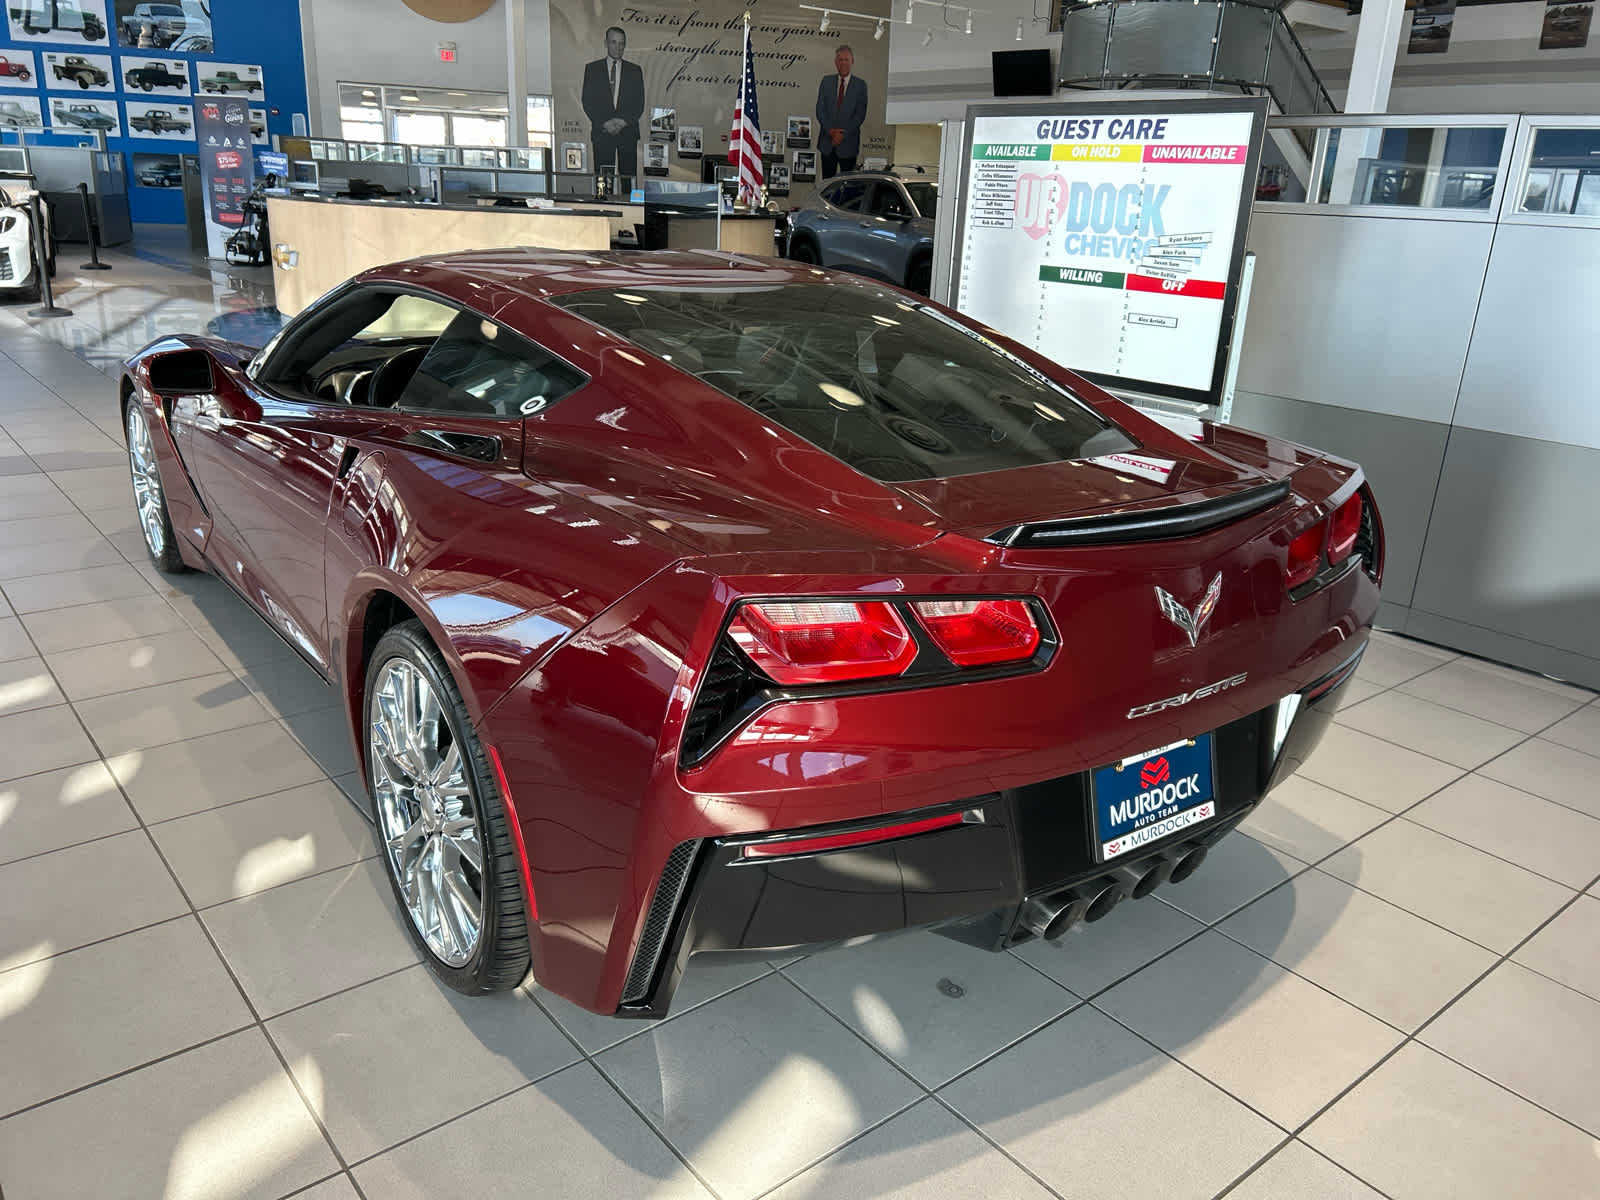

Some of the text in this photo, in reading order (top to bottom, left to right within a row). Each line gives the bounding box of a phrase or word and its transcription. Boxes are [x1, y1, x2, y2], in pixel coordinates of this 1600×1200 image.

[620, 8, 841, 43] For it is from thee we gain our
[656, 39, 720, 64] strength
[666, 65, 694, 92] for
[695, 75, 719, 84] our
[1037, 118, 1169, 140] GUEST CARE
[985, 146, 1038, 157] AVAILABLE
[1071, 146, 1121, 159] ON HOLD
[1151, 147, 1237, 160] UNAVAILABLE
[1059, 269, 1103, 283] WILLING
[1161, 279, 1187, 292] OFF
[1126, 672, 1248, 720] CORVETTE
[1109, 773, 1201, 827] MURDOCK
[1134, 804, 1178, 828] AUTO TEAM
[1131, 813, 1191, 847] MURDOCK
